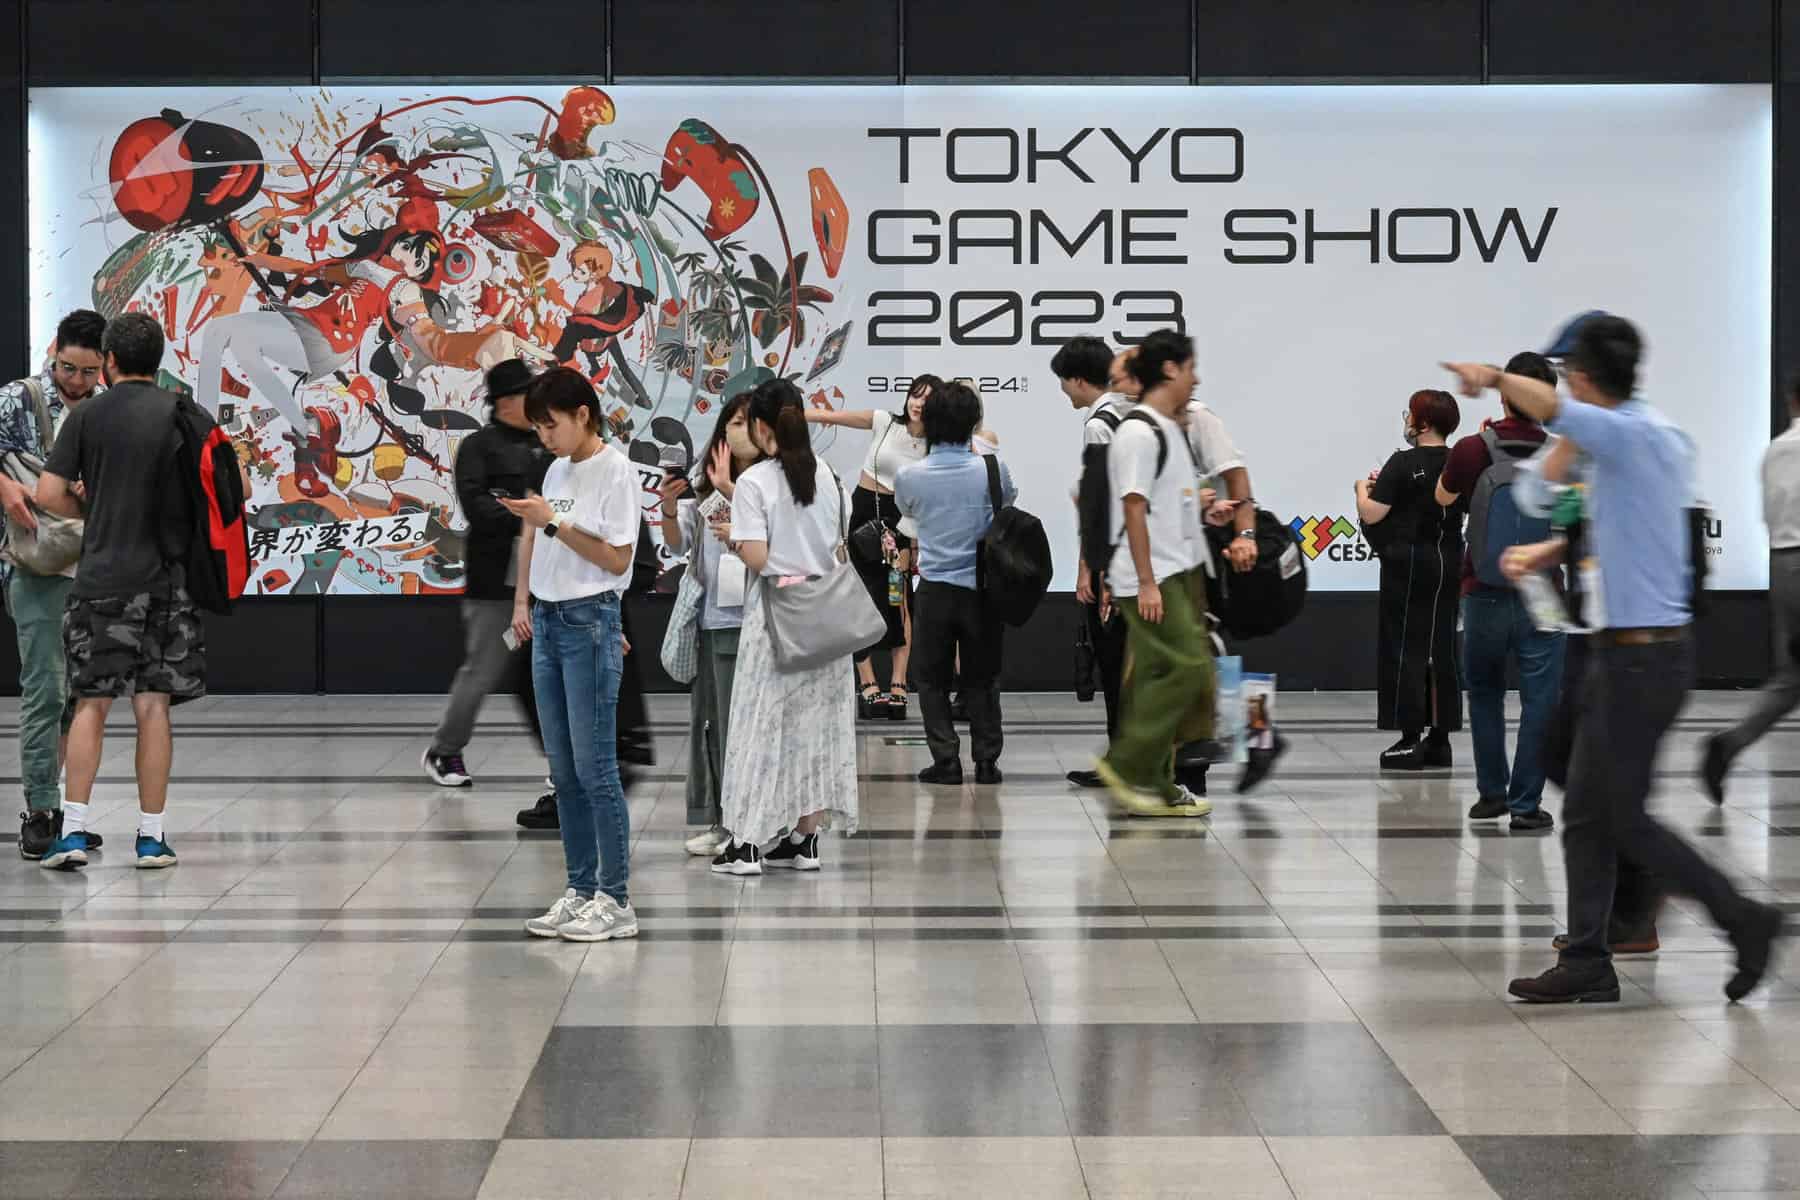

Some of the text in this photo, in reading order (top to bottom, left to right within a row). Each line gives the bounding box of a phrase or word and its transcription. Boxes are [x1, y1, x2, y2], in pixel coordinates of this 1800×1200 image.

[868, 128, 1244, 183] TOKYO
[868, 208, 1558, 264] GAME SHOW
[868, 290, 1184, 345] 2023
[868, 376, 914, 393] 9.2
